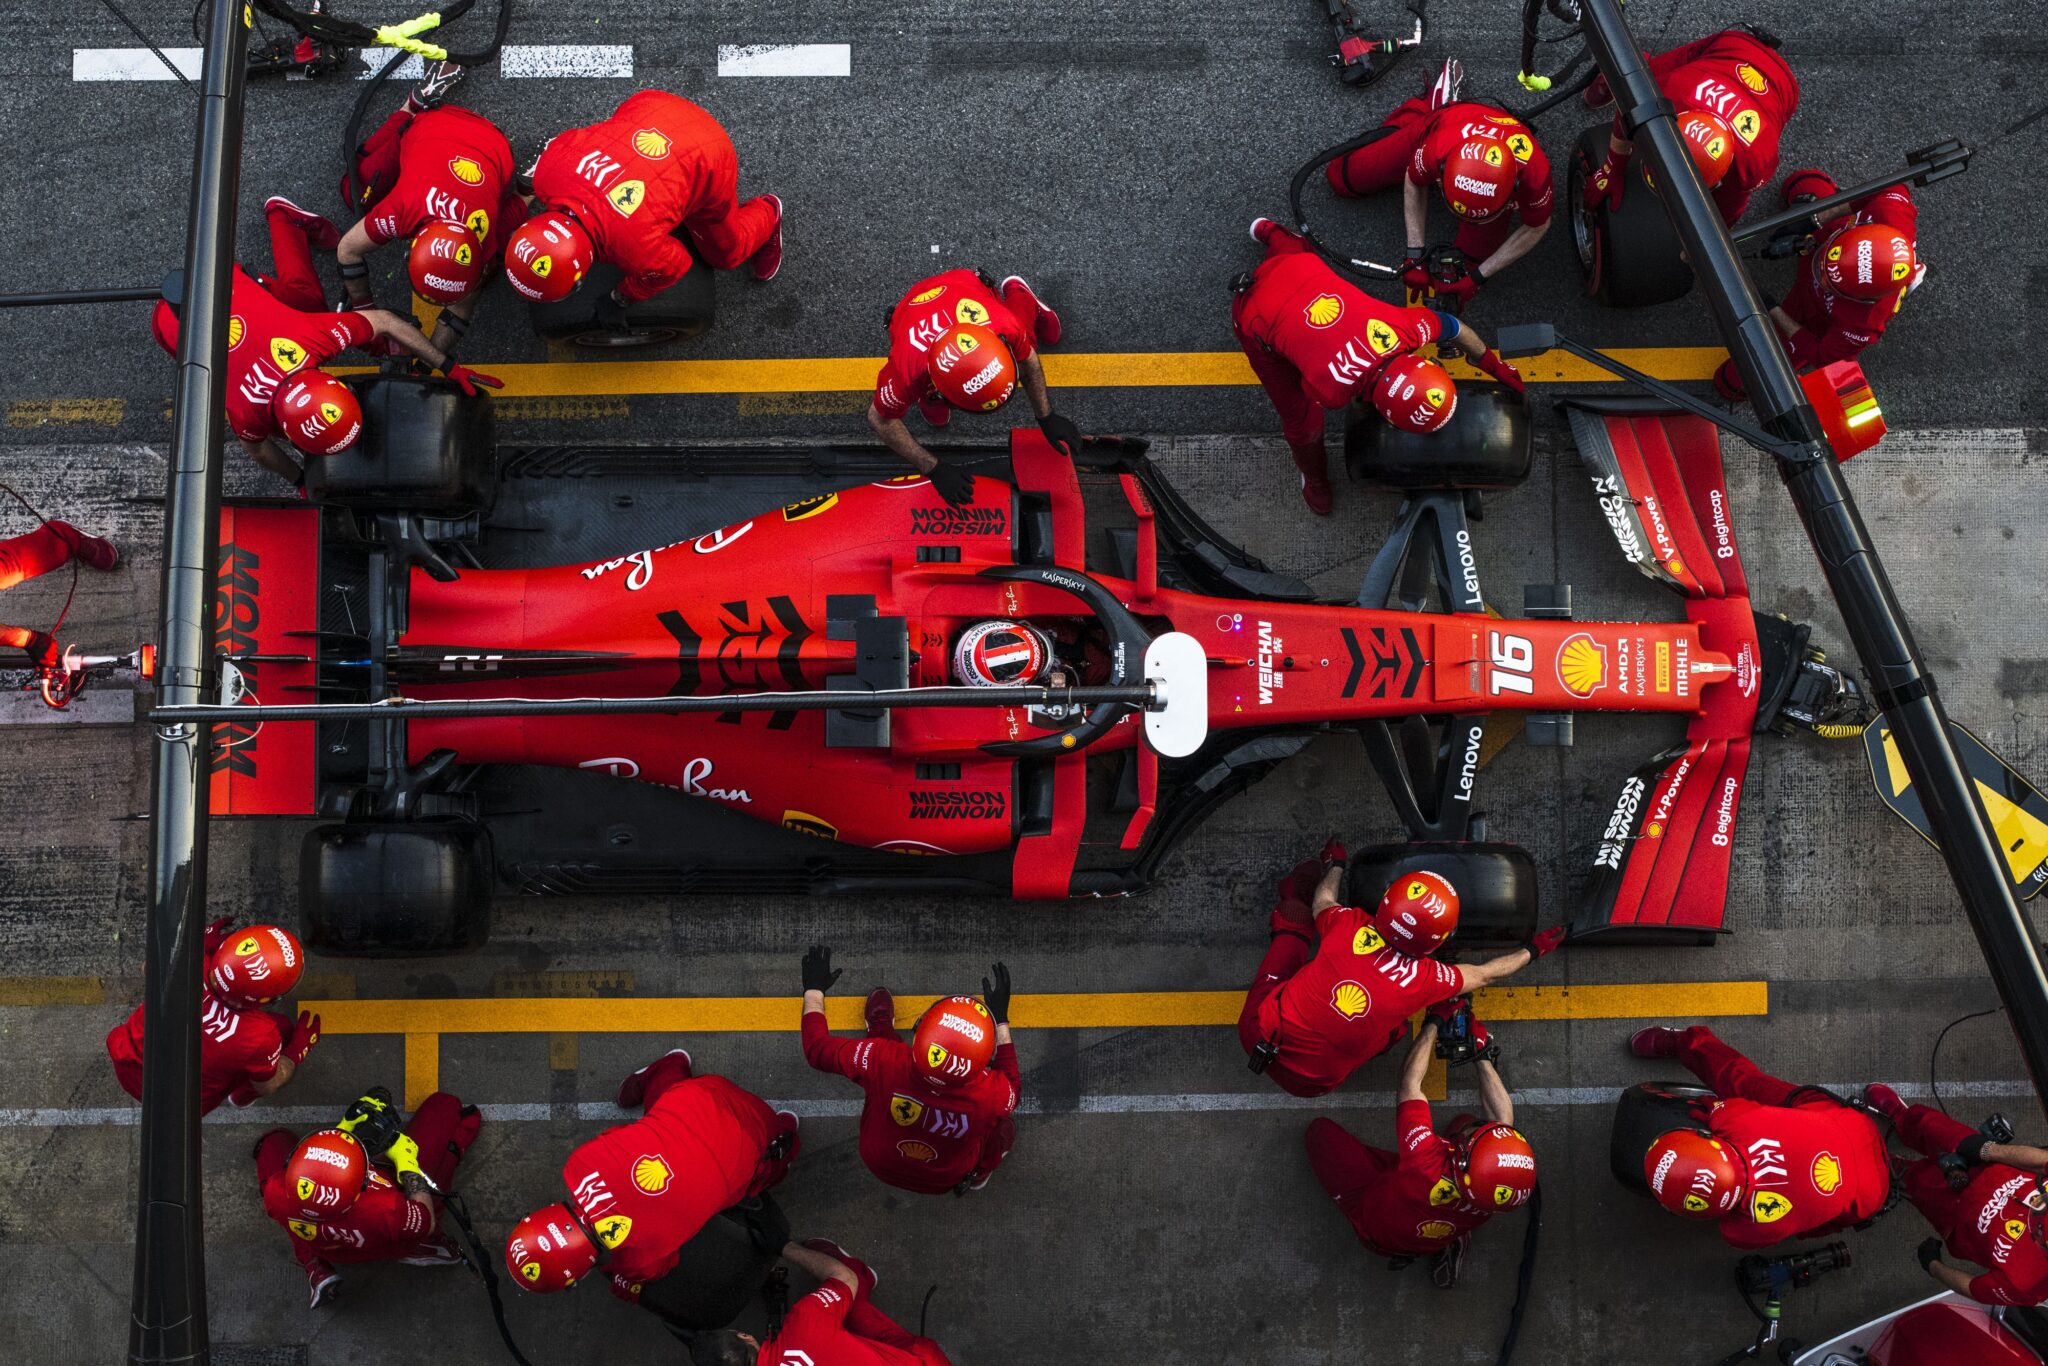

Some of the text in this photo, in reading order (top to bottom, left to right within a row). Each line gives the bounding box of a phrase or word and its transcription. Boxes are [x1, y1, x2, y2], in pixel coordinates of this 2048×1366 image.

[910, 507, 1006, 521] WINNOW
[911, 521, 1006, 536] MISSION
[1644, 495, 1675, 559] V-Power
[1456, 529, 1483, 605] Lenovo
[1258, 620, 1273, 705] WEICHAI
[1489, 630, 1535, 697] 16
[1618, 652, 1629, 695] AMD
[1636, 643, 1647, 696] KASPERSKY
[1676, 638, 1689, 697] MAHLE
[1454, 726, 1483, 802] Lenovo
[1654, 759, 1690, 821] V-Power
[908, 791, 1006, 805] MISSION
[909, 805, 1006, 820] WINNOW
